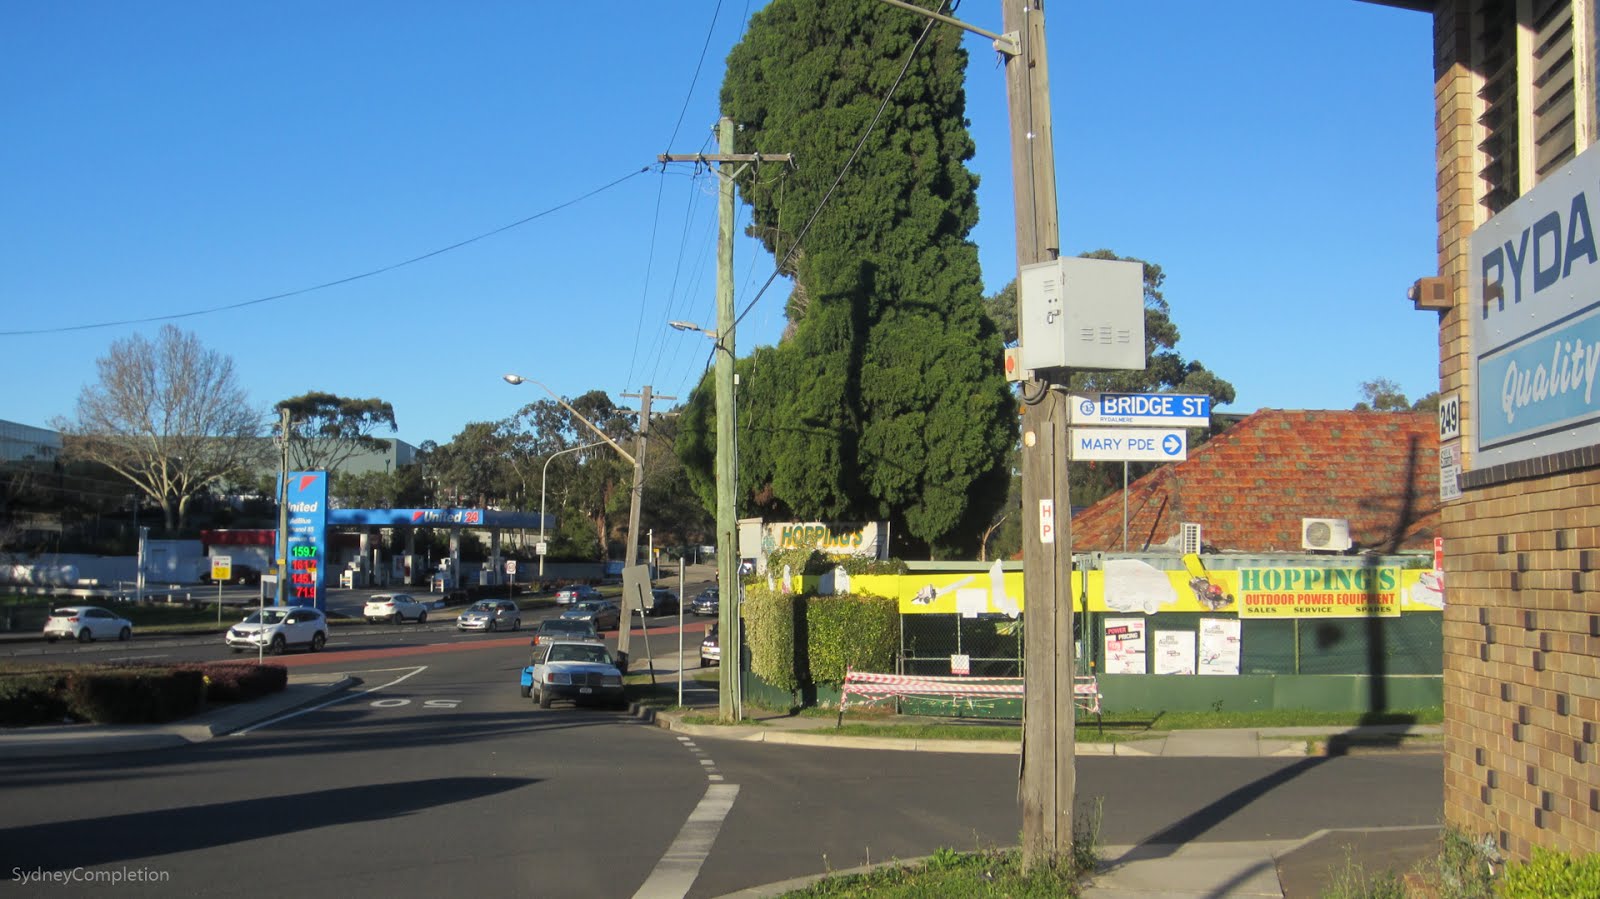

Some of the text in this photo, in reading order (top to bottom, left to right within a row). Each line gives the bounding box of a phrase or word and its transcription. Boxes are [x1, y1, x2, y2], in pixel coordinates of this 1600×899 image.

[1482, 191, 1600, 320] RYDA
[1502, 338, 1600, 424] Quality
[1104, 396, 1205, 416] BRIDGE ST
[1440, 401, 1457, 435] 249
[1081, 438, 1155, 450] MARY PDE
[424, 511, 479, 523] United 24
[292, 546, 317, 557] 159.7
[1241, 568, 1395, 591] HOPPING'S
[1245, 593, 1395, 605] OUTDOOR POWER EQUIPMENT
